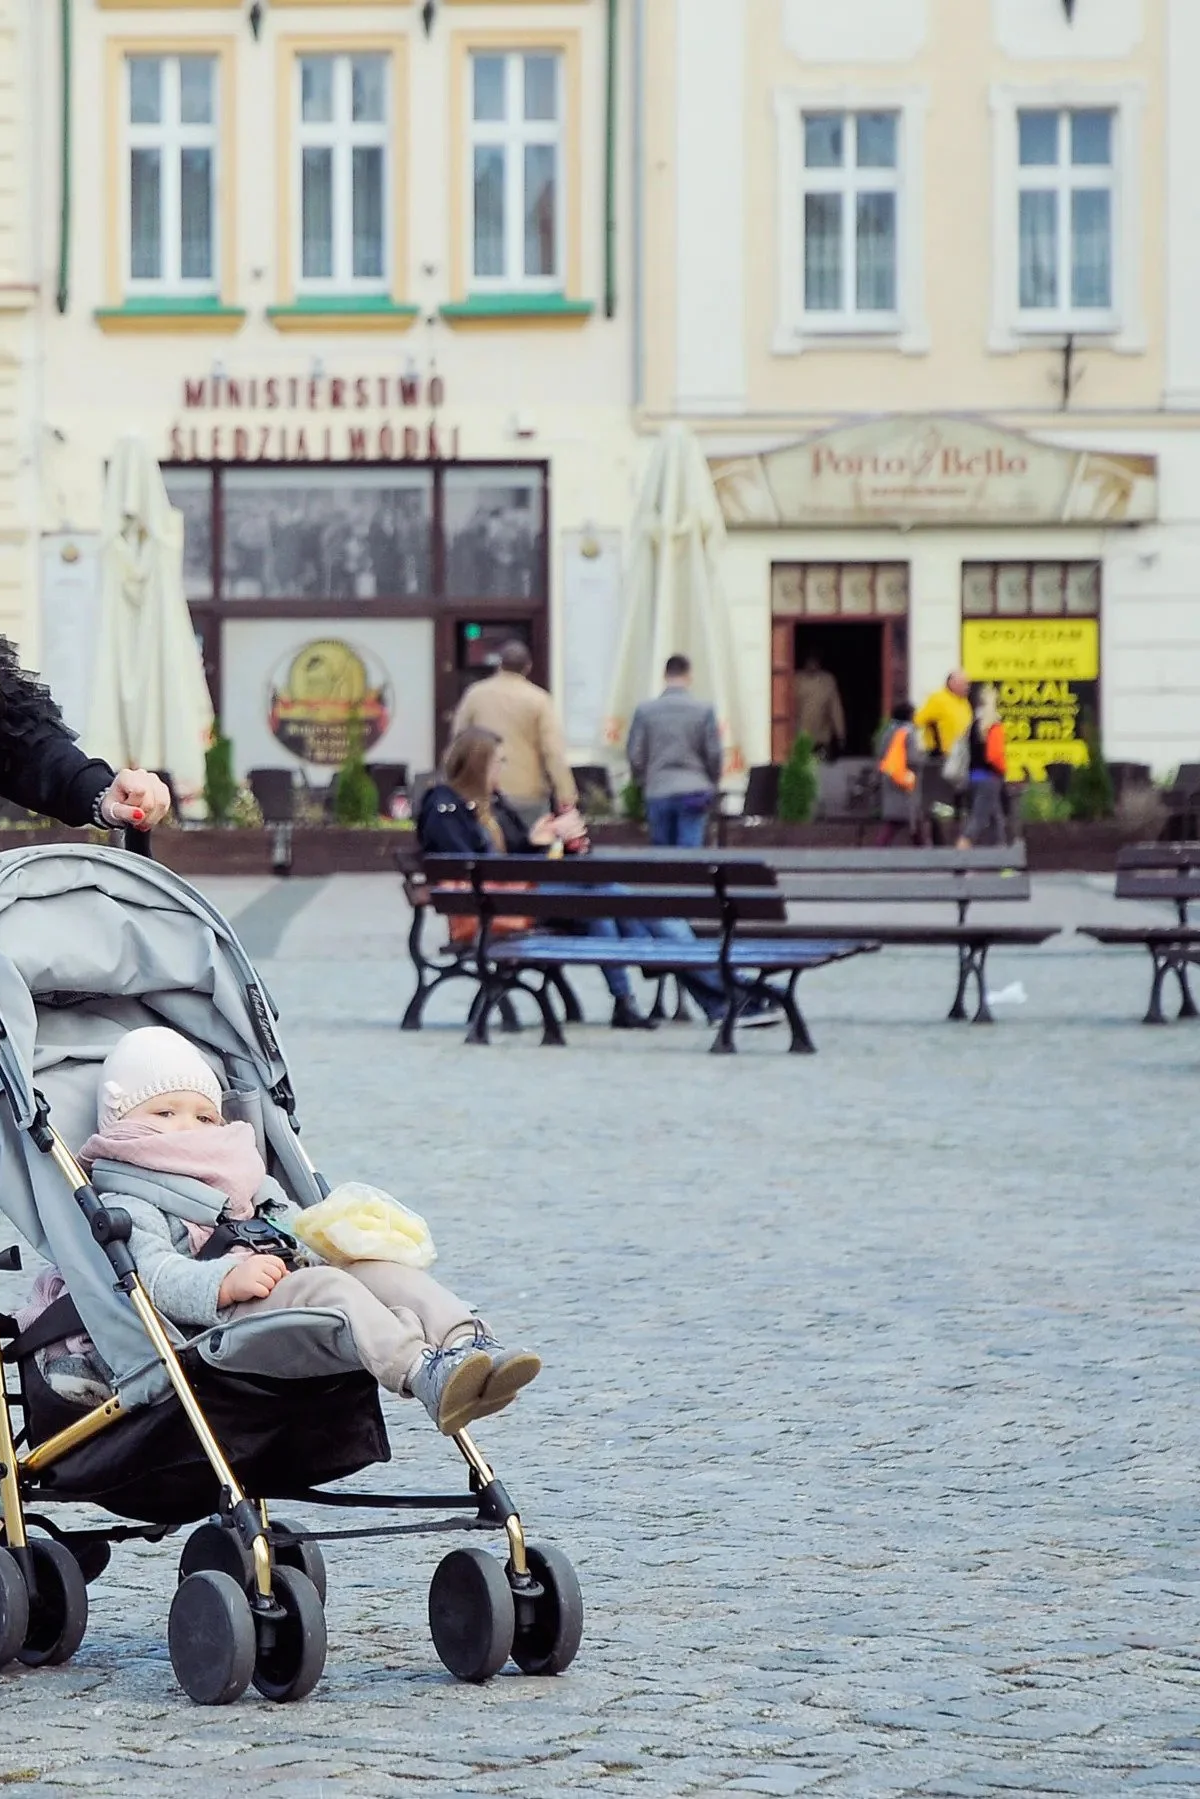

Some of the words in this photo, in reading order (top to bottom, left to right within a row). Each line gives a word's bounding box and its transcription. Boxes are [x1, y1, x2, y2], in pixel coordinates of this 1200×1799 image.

[183, 376, 445, 409] MINISTERSTWO
[811, 445, 904, 477] Porto
[940, 445, 1028, 476] Bello
